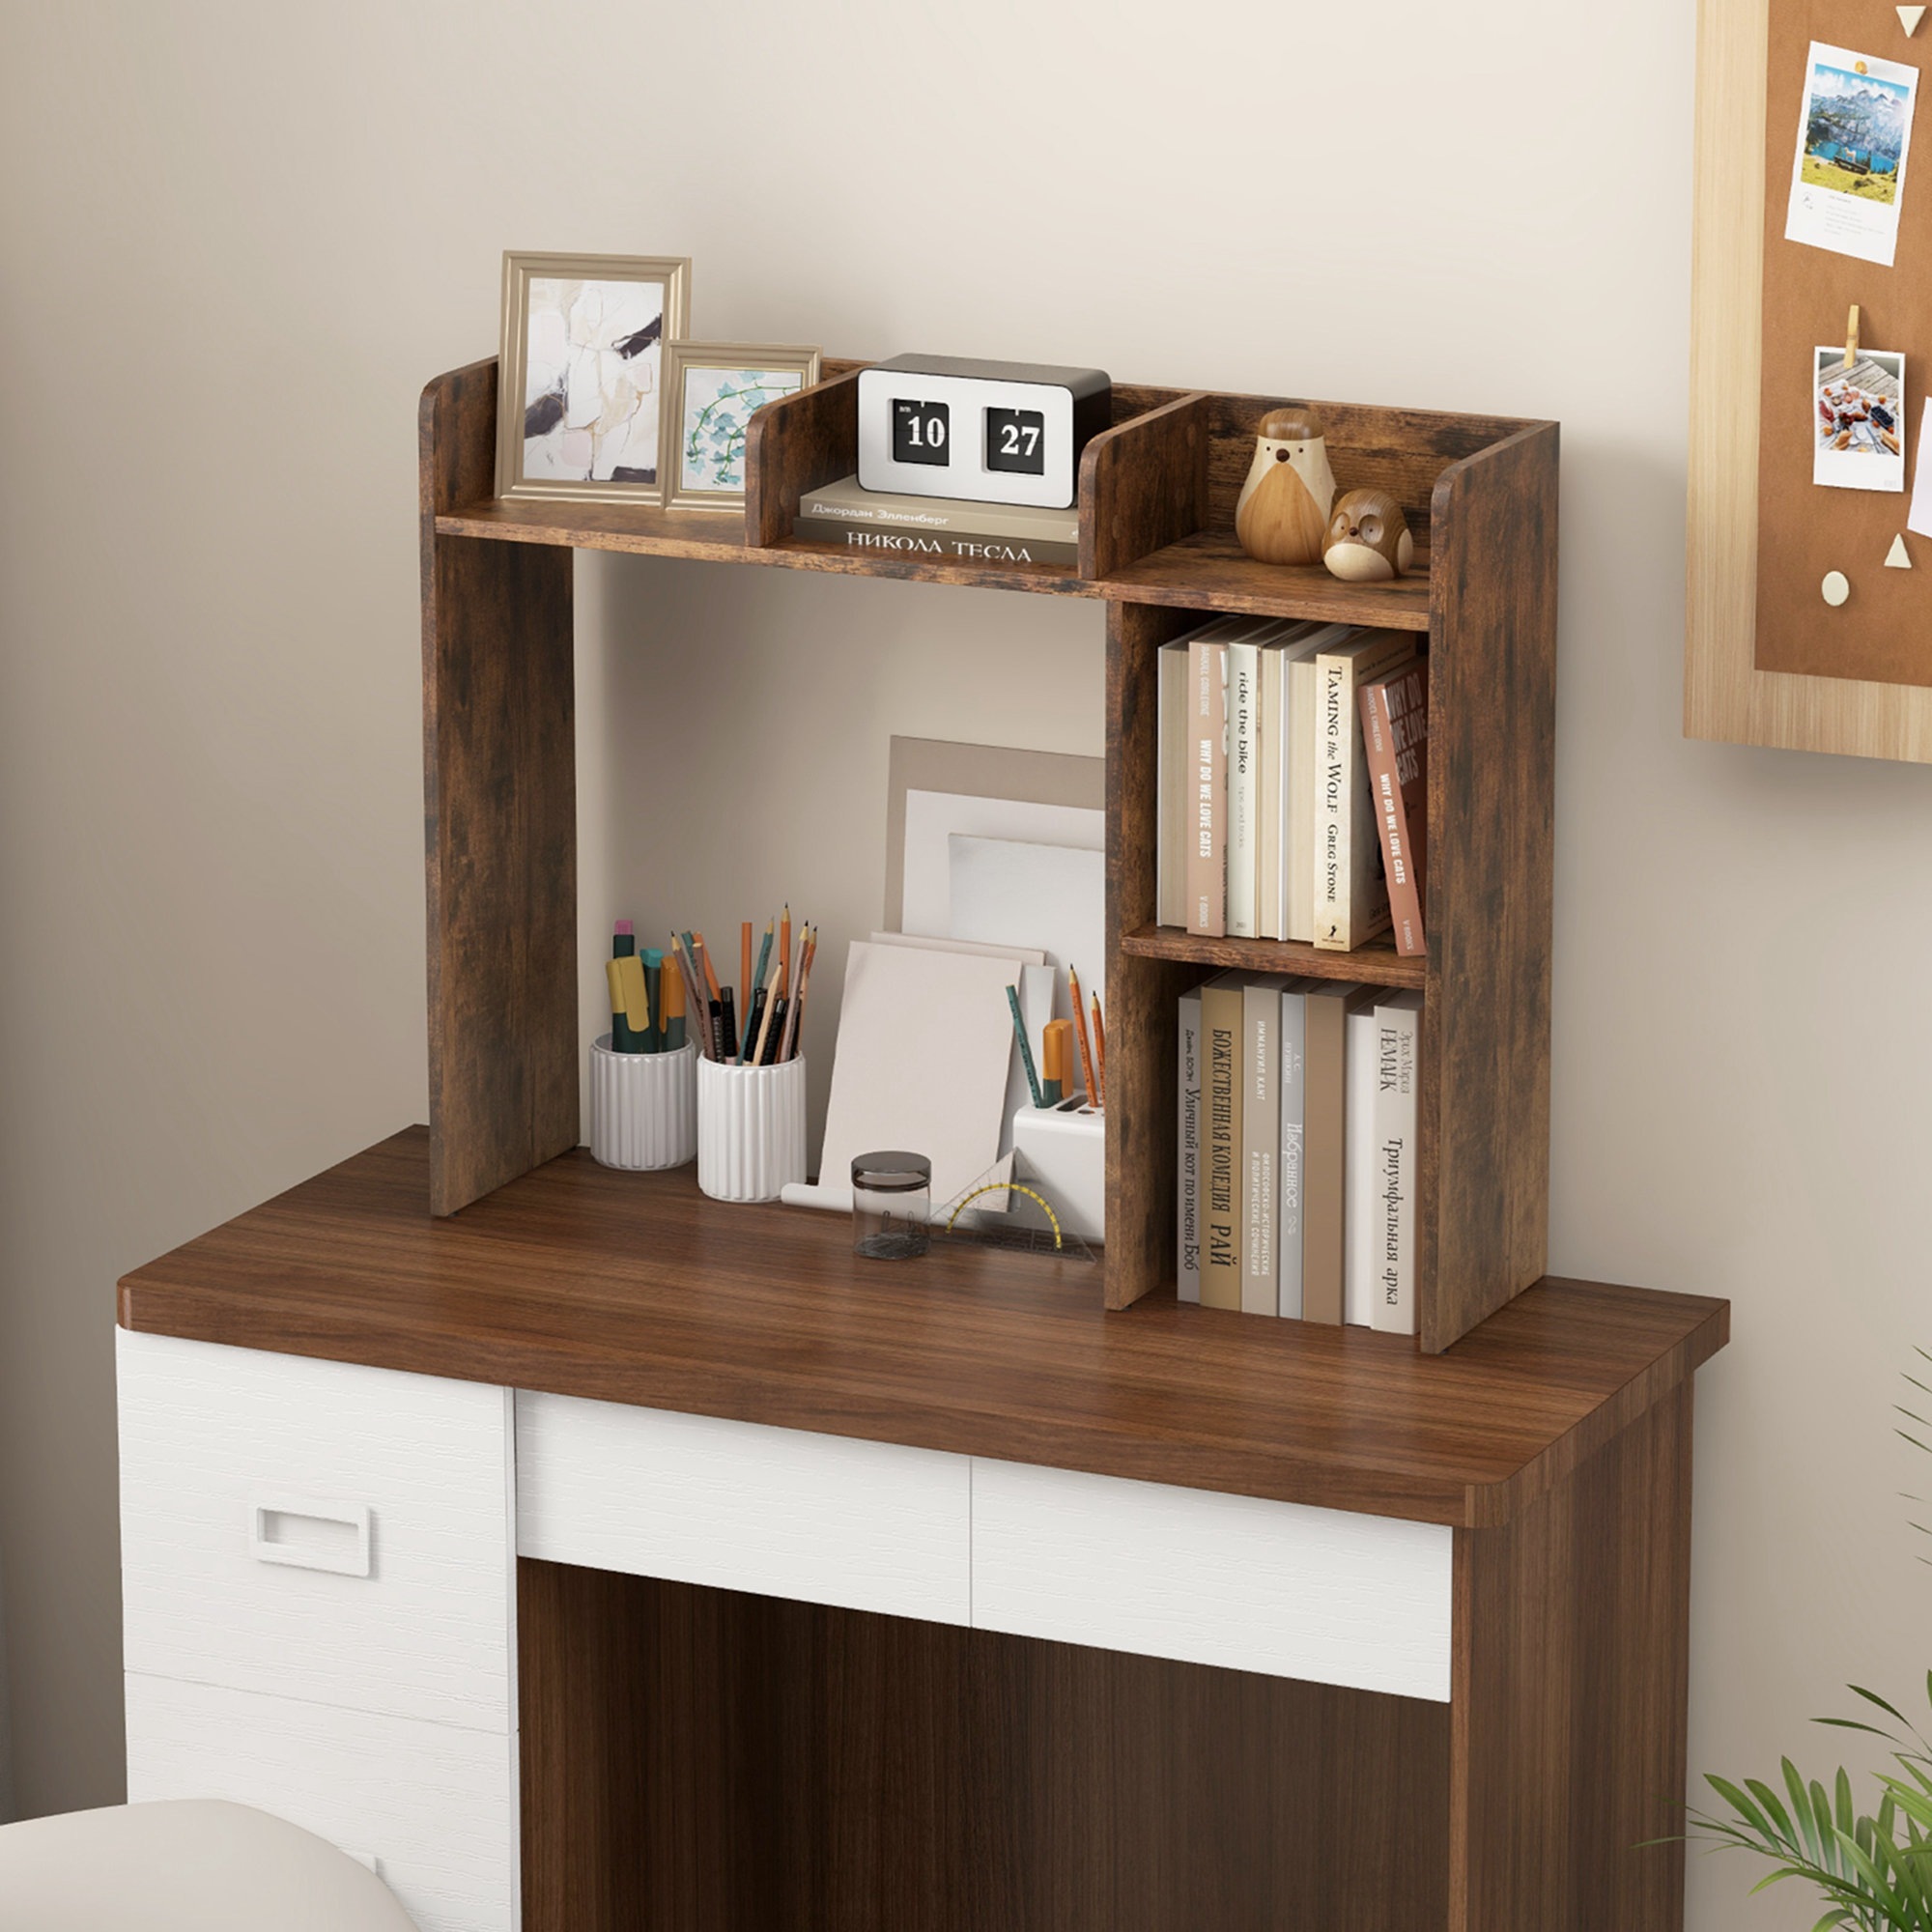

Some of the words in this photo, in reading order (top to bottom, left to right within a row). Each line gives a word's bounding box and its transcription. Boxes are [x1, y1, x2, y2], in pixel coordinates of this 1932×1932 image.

[908, 416, 946, 447] 10
[1000, 424, 1040, 456] 27
[811, 503, 873, 519] Джордан
[877, 509, 949, 526] Элленберг
[846, 531, 943, 554] НИКОЛА
[952, 541, 1033, 562] ТЕСЛА
[1238, 671, 1249, 703] ride
[1327, 667, 1343, 736] TAMING
[1238, 709, 1248, 735] the
[1200, 740, 1211, 764] WHY
[1238, 740, 1248, 774] bike
[1327, 741, 1338, 760] the
[1200, 766, 1211, 781] DO
[1326, 763, 1342, 813] WOLF
[1379, 773, 1392, 795] WHY
[1200, 783, 1211, 800] WE
[1384, 799, 1395, 812] DO
[1199, 803, 1211, 828] LOVE
[1386, 814, 1398, 831] WE
[1199, 831, 1211, 858] CATS
[1327, 824, 1338, 859] GREG
[1389, 833, 1402, 857] LOVE
[1327, 863, 1338, 903] STONE
[1393, 859, 1406, 885] CATS
[1256, 1020, 1265, 1073] ИММАНУИЛ
[1211, 1029, 1232, 1142] БОЖЕСТВЕННАЯ
[1256, 1076, 1265, 1101] КАНТ
[1185, 1088, 1201, 1149] Уличный
[1185, 1152, 1195, 1176] кот
[1209, 1145, 1232, 1212] КОМЕДИЯ
[1282, 1122, 1302, 1208] Избранное
[1184, 1179, 1195, 1196] по
[1382, 1138, 1404, 1262] Триумфальная
[1184, 1198, 1195, 1240] имени
[1184, 1243, 1200, 1271] Боб
[1210, 1224, 1237, 1267] РАЙ
[1381, 1267, 1399, 1305] арка
